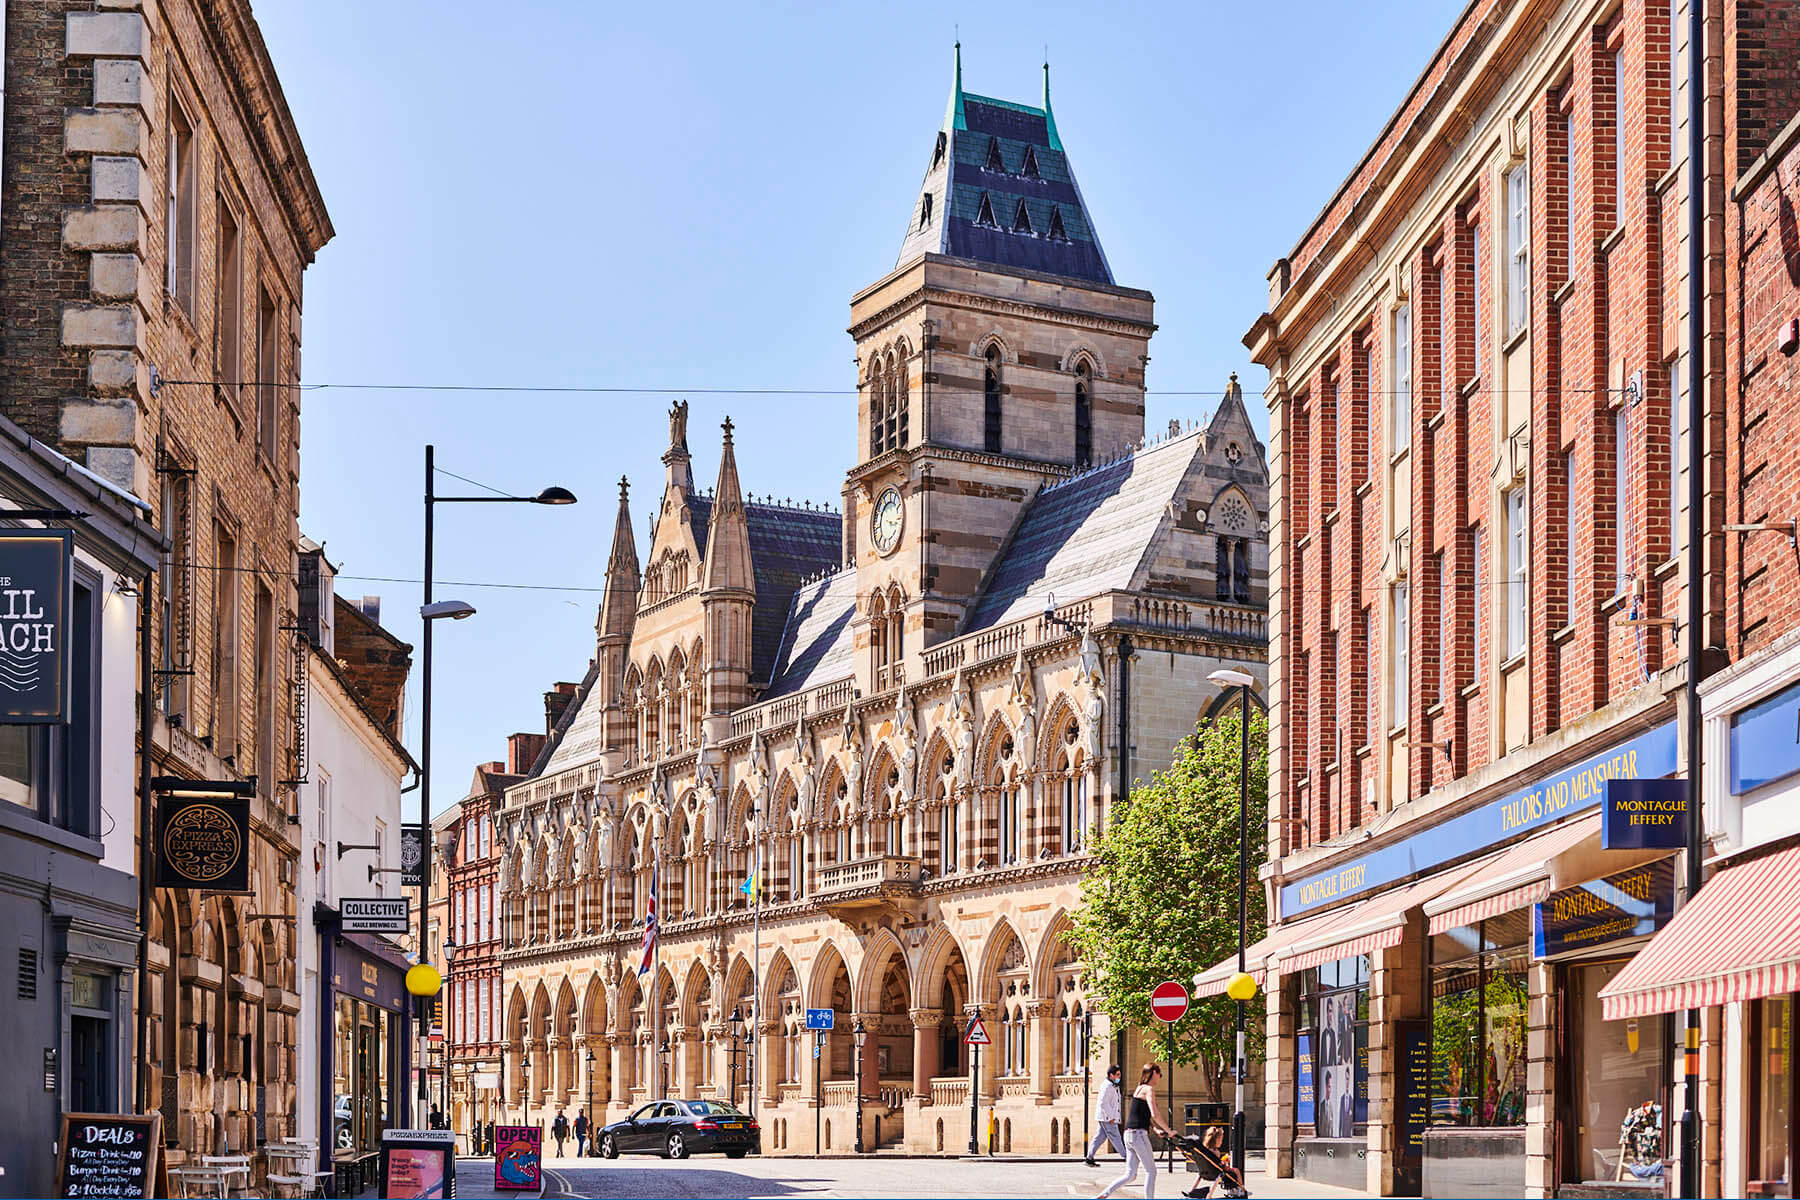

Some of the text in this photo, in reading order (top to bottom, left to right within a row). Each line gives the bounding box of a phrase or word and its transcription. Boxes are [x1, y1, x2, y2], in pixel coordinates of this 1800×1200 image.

[0, 590, 43, 619] IL
[1501, 750, 1638, 832] TAILORS AND MENSWEAR
[1616, 800, 1688, 811] MONTAGUE
[1629, 814, 1674, 826] JEFFERY
[183, 831, 221, 841] PIZZA
[172, 840, 232, 851] EXPRESS
[1299, 864, 1366, 905] MONTAGUE JEFFERY
[1553, 872, 1651, 922] MONTAGUE JEFFERY
[345, 903, 404, 915] COLLECTIVE
[84, 1126, 134, 1144] DEALS
[499, 1129, 538, 1142] OPEN
[71, 1147, 96, 1158] Pizza
[100, 1148, 120, 1158] Drink
[69, 1164, 97, 1177] Burger
[102, 1165, 120, 1175] Drink
